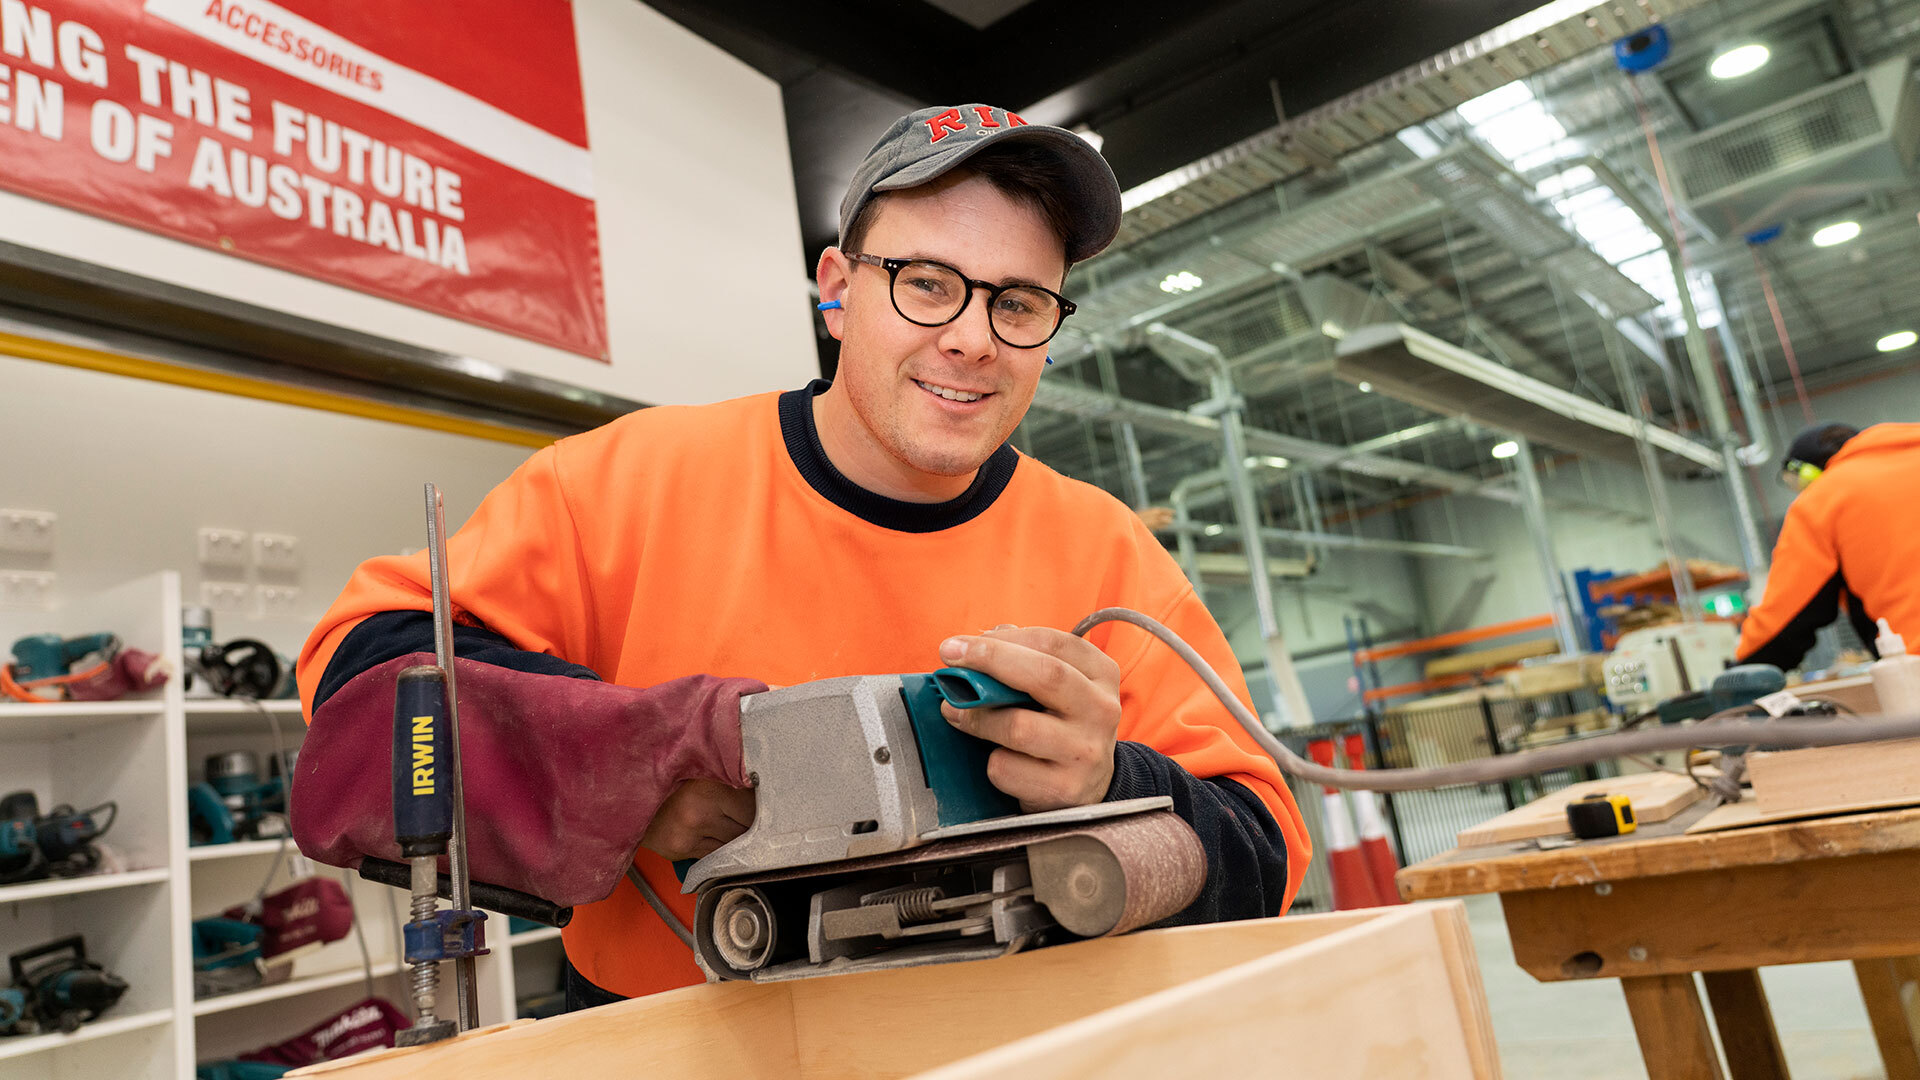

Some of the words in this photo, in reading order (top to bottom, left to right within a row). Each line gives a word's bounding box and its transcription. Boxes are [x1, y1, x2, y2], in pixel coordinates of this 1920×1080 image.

[0, 0, 108, 89] NG
[125, 44, 253, 142] THE
[273, 100, 465, 222] FUTURE
[205, 0, 384, 91] ACCESSORIES
[0, 63, 64, 142] N
[91, 99, 174, 173] OF
[188, 136, 470, 276] AUSTRALIA
[412, 716, 434, 796] IRWIN
